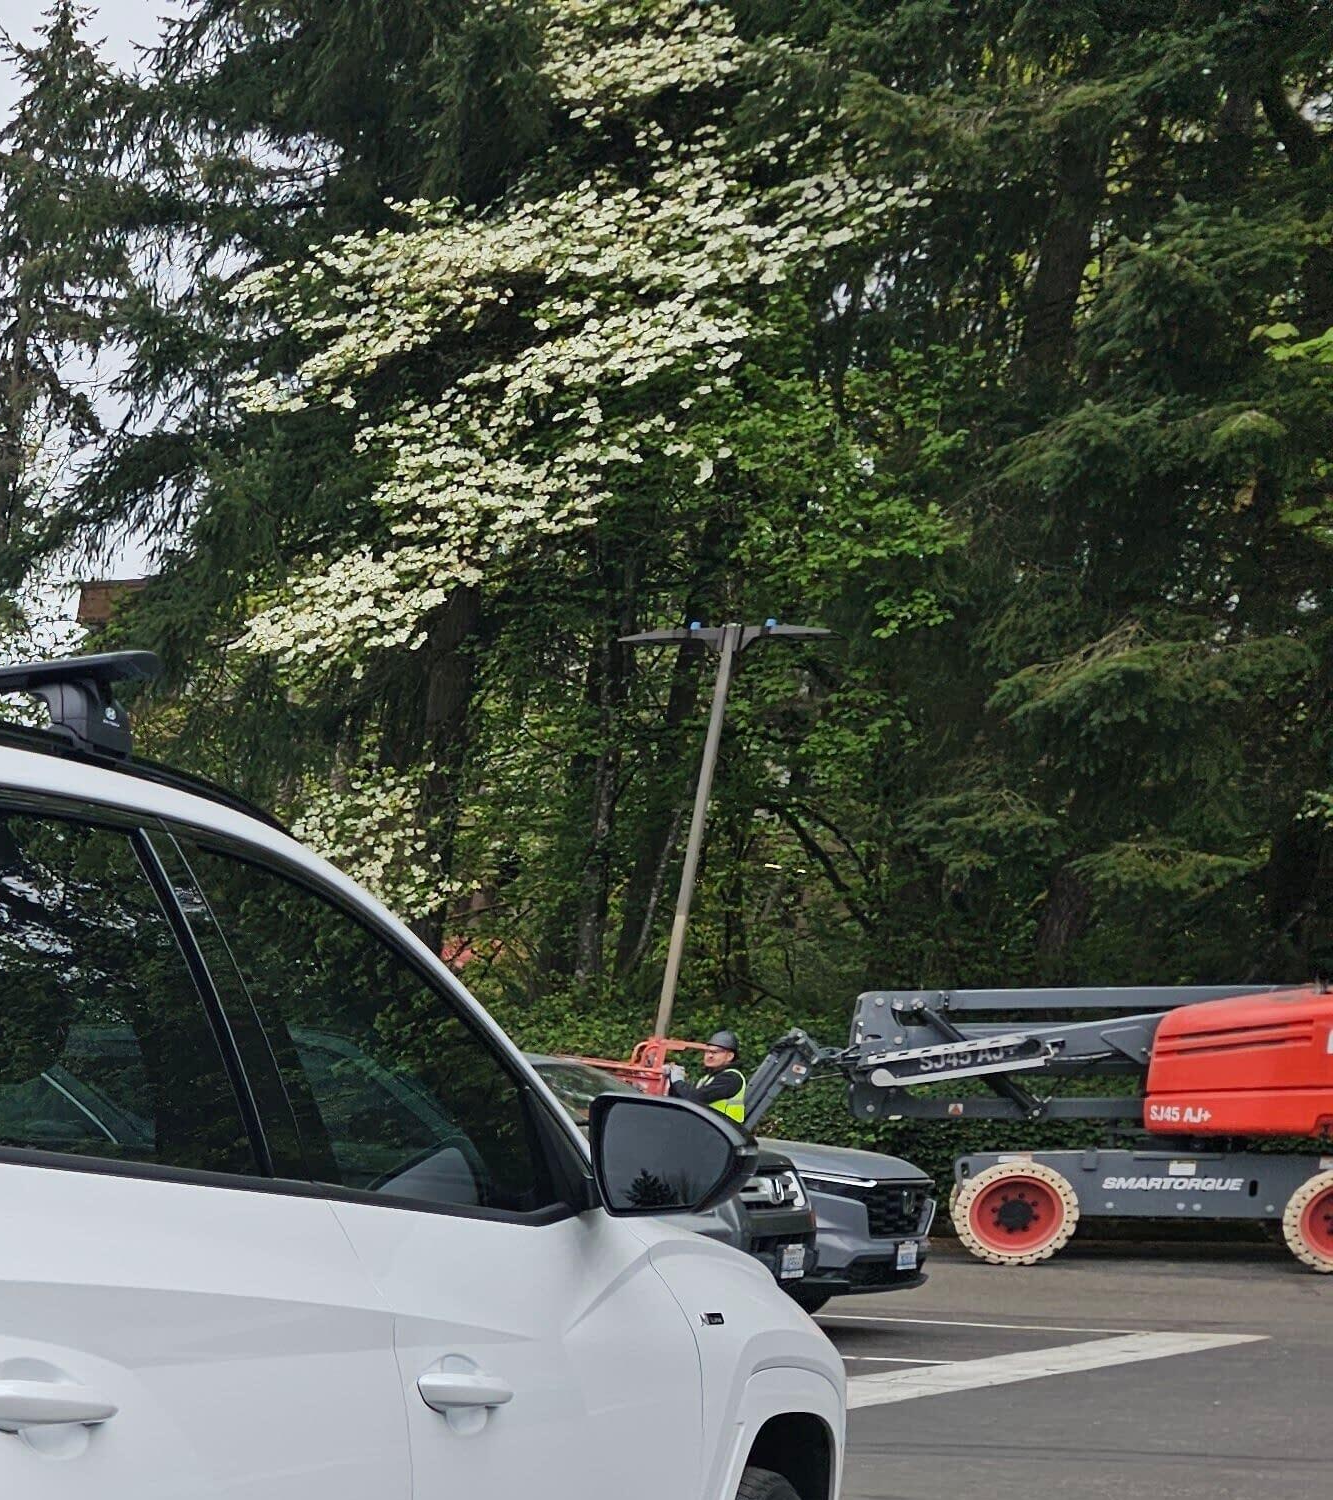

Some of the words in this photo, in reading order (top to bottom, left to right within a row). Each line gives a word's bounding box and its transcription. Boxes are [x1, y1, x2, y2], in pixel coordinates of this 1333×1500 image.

[919, 1047, 974, 1072] SJ45
[1150, 1103, 1180, 1121] SJ45
[1183, 1105, 1212, 1123] AJ+
[1101, 1176, 1244, 1192] SMARTORQUE
